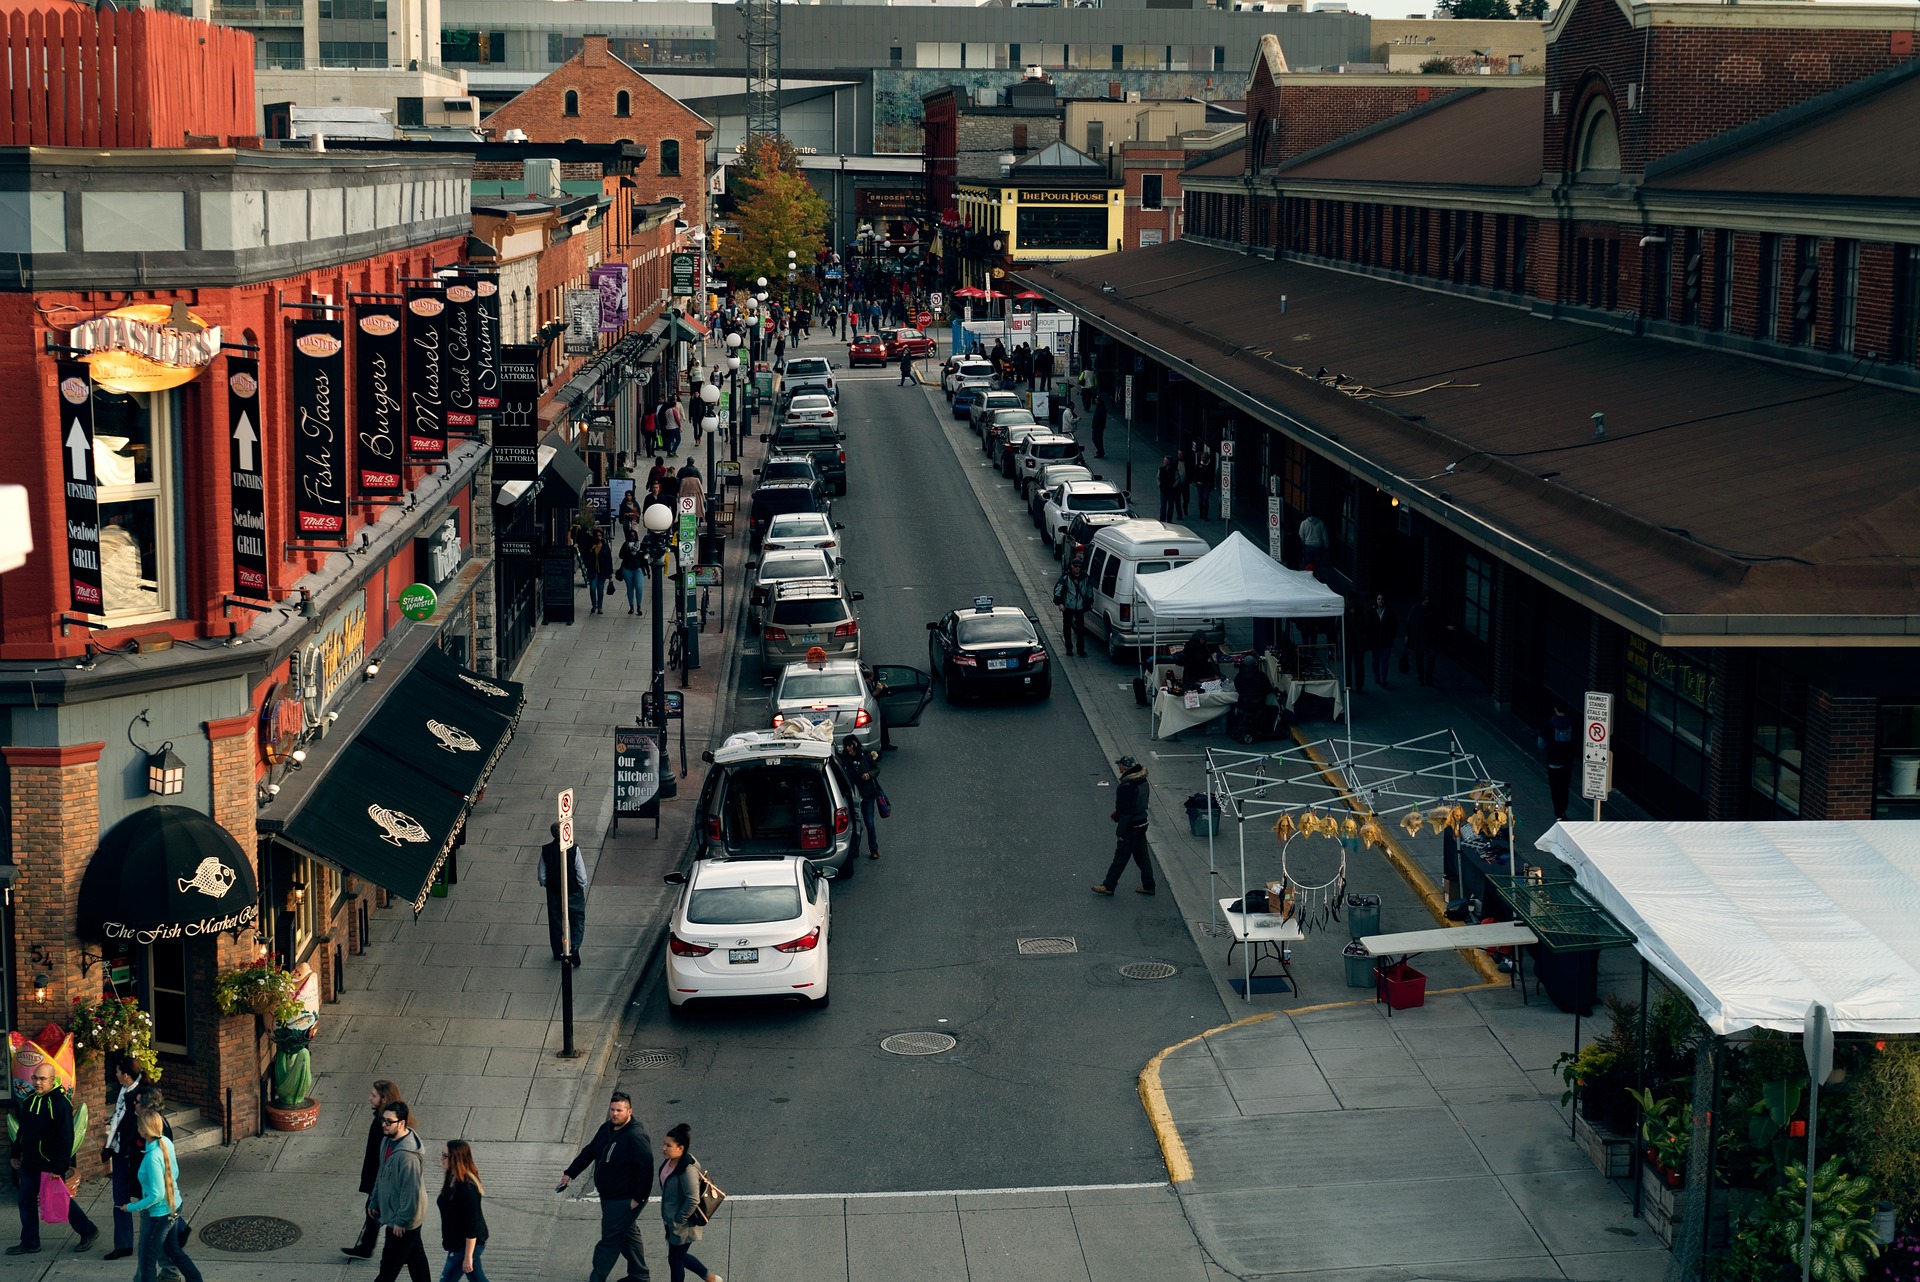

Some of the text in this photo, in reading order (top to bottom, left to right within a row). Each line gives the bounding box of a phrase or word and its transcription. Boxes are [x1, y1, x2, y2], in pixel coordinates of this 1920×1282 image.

[788, 145, 817, 154] entre
[1022, 192, 1104, 200] THE POUR HOUSE
[412, 300, 442, 311] COASTERS
[360, 316, 396, 329] COASTERS
[574, 304, 582, 336] KITCHEN
[80, 317, 212, 367] COASTERS
[300, 336, 338, 350] COASTERS
[478, 303, 498, 390] Shrimp
[448, 307, 473, 408] Crab Cakes
[230, 373, 258, 392] COASTERS
[412, 324, 442, 432] Mussels
[62, 378, 89, 398] COASTERS
[300, 369, 334, 442] Tacos
[360, 352, 400, 460] Burgers
[448, 414, 464, 422] Mill
[413, 440, 430, 448] Mill
[588, 431, 604, 446] M
[233, 472, 263, 490] UPSTAIRS
[303, 446, 341, 505] Fish
[365, 474, 395, 483] Mill St.
[67, 482, 96, 500] UPSTAIRS
[586, 498, 607, 508] 25%
[233, 508, 264, 530] Seafood
[303, 517, 338, 526] Mill St.
[68, 520, 98, 542] Seafood
[237, 535, 263, 556] GRILL
[72, 548, 98, 570] GRILL
[240, 571, 254, 580] Mill
[76, 586, 90, 595] Mill
[402, 596, 424, 605] STEAM
[406, 599, 434, 610] WHISTLE
[618, 756, 636, 767] Our
[617, 770, 653, 782] Kitchen
[617, 785, 652, 798] is Open
[617, 800, 640, 811] Late!
[103, 922, 135, 938] The
[136, 923, 181, 944] Fish
[185, 913, 238, 936] Market
[32, 946, 53, 970] 54
